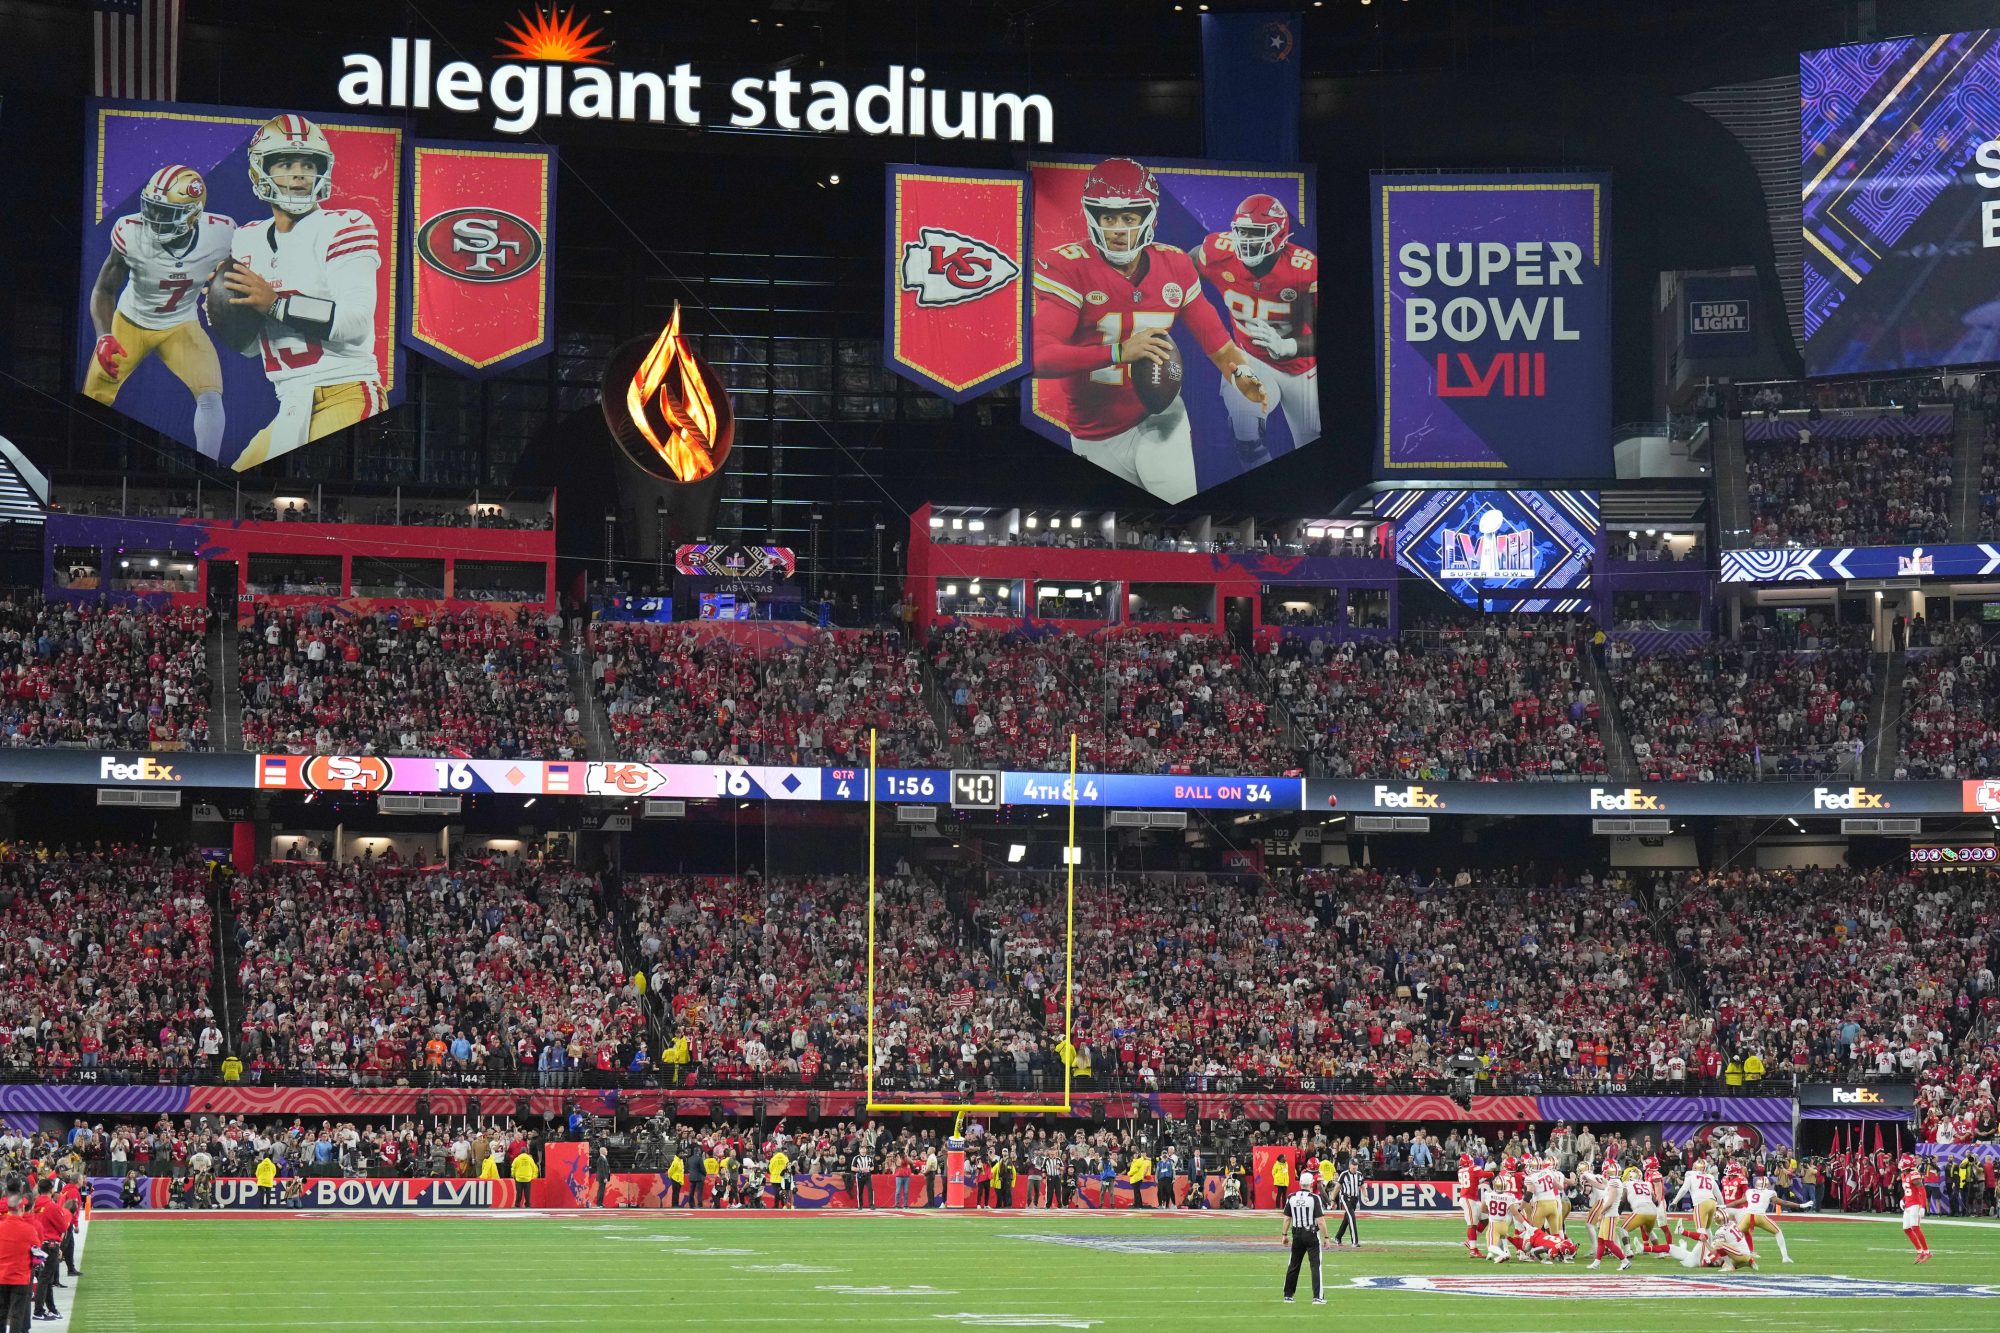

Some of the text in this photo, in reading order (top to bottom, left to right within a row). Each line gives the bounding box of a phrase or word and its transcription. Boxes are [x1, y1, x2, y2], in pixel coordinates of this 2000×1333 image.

[337, 37, 1054, 143] allegiant stadium
[1913, 129, 1945, 161] VEGAS
[453, 218, 519, 272] SF
[928, 245, 992, 290] KC
[1399, 242, 1583, 287] SUPER
[154, 279, 194, 313] 7
[1405, 297, 1580, 342] BOWL
[1701, 304, 1739, 317] BUD
[1694, 316, 1746, 331] LIGHT
[1437, 352, 1545, 397] LVIII
[720, 584, 738, 592] LAS
[100, 756, 174, 781] FedEx
[327, 756, 378, 790] SF
[434, 761, 473, 790] 16
[832, 770, 855, 780] QTR
[605, 764, 649, 793] KC
[713, 768, 750, 796] 16
[887, 776, 935, 796] 1:56
[836, 781, 850, 798] 4
[958, 775, 993, 803] 40
[1023, 779, 1098, 800] 4TH & 4
[1174, 784, 1271, 802] BALL ON 34
[1374, 785, 1440, 809] FedEx
[1590, 788, 1658, 811] FedEx
[1814, 787, 1883, 810] FedEx
[194, 807, 245, 816] 143 144
[582, 816, 630, 825] 144 101
[944, 825, 959, 834] 102
[1274, 829, 1320, 838] 102 103
[1251, 838, 1301, 856] EER
[80, 1070, 97, 1080] 143
[460, 1074, 478, 1083] 144
[880, 1077, 894, 1086] 101
[1300, 1081, 1315, 1090] 102
[1612, 1084, 1627, 1092] 103
[1832, 1087, 1879, 1103] FedEx
[1538, 1174, 1553, 1192] 78
[1633, 1182, 1651, 1196] 65
[1695, 1175, 1713, 1191] 76
[318, 1180, 418, 1205] BOWL
[433, 1180, 493, 1205] LVIII
[1362, 1184, 1437, 1207] UPER
[1724, 1187, 1738, 1201] 27
[1750, 1193, 1760, 1204] 9
[1296, 1199, 1306, 1208] 52
[1489, 1200, 1508, 1217] 89
